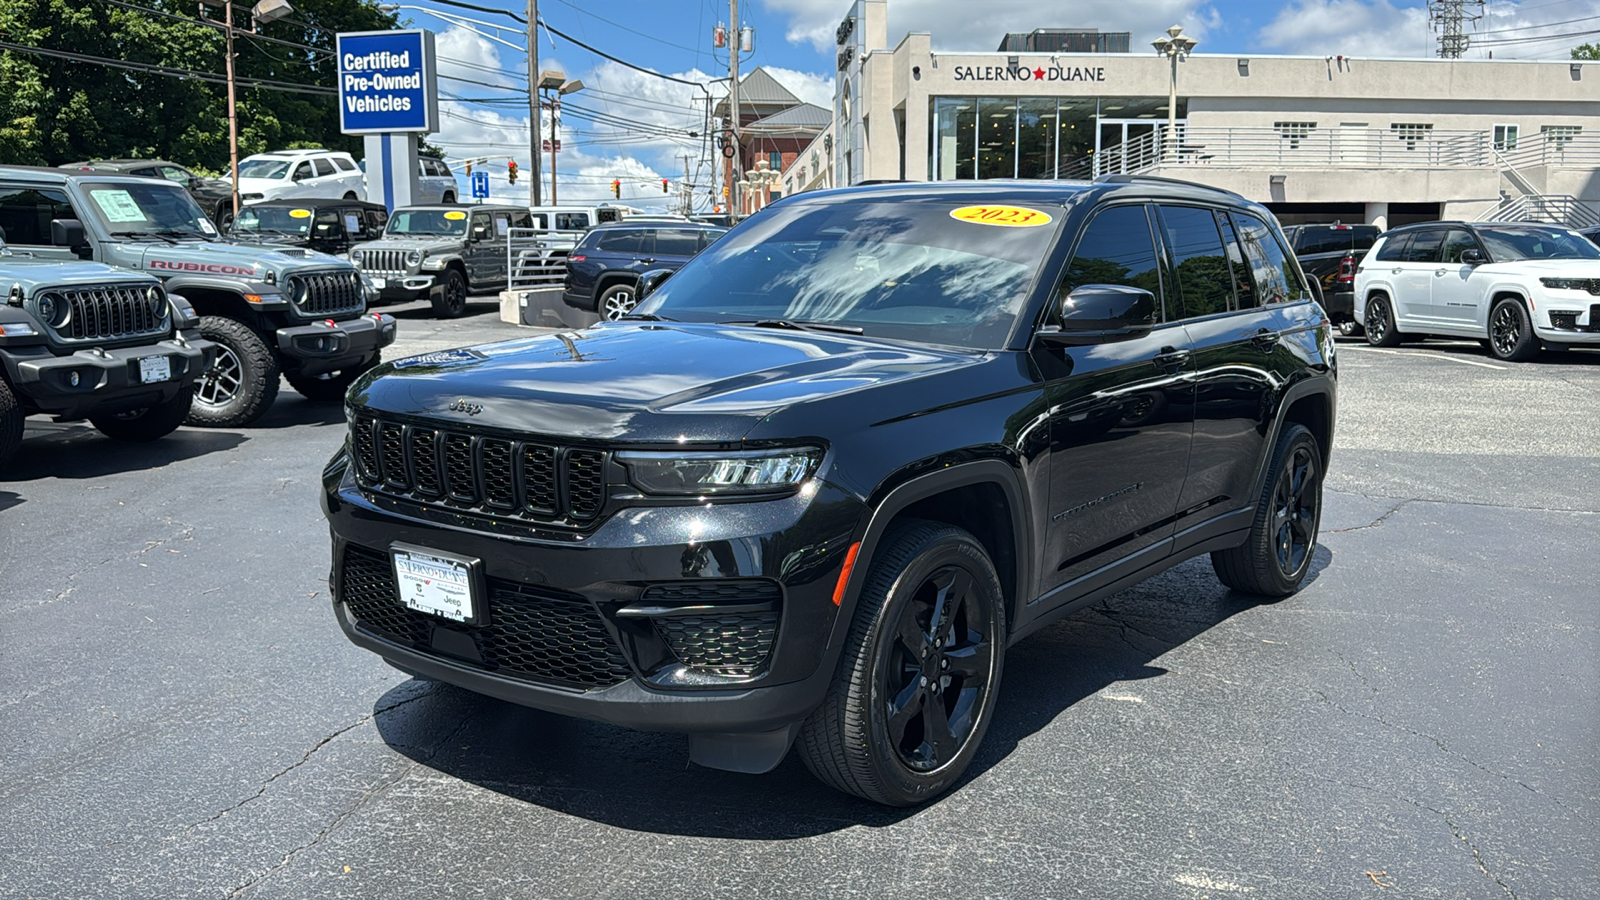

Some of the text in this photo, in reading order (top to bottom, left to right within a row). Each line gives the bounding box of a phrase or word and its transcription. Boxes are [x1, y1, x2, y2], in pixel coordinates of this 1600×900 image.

[343, 50, 410, 71] Certified
[344, 71, 420, 92] Pre-Owned
[954, 66, 1105, 81] SALERNO DUANE
[346, 94, 411, 113] Vehicles
[475, 177, 485, 191] H
[963, 208, 1036, 223] 2023
[150, 259, 255, 276] RUBICON
[449, 398, 484, 416] Jeep
[398, 560, 467, 585] SALERNO DUANE
[443, 594, 462, 608] Jeep
